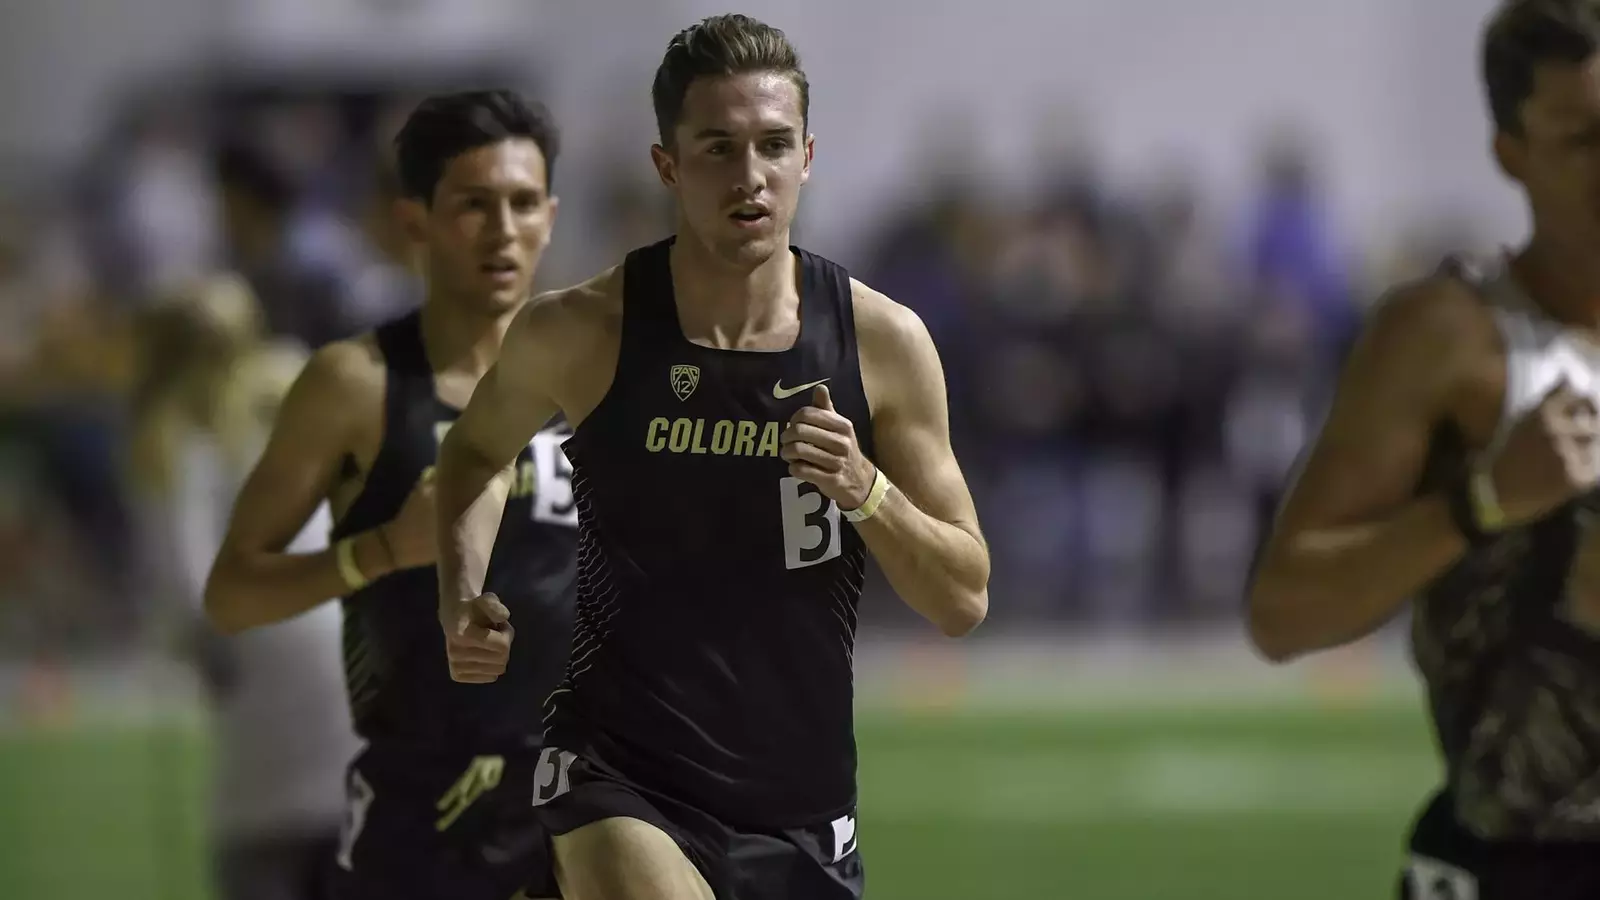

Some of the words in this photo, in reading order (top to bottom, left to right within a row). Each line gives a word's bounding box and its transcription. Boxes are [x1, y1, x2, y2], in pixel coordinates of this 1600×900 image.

[672, 366, 699, 387] PAC
[677, 380, 691, 393] 12
[645, 417, 779, 458] COLORA
[797, 481, 832, 562] 3
